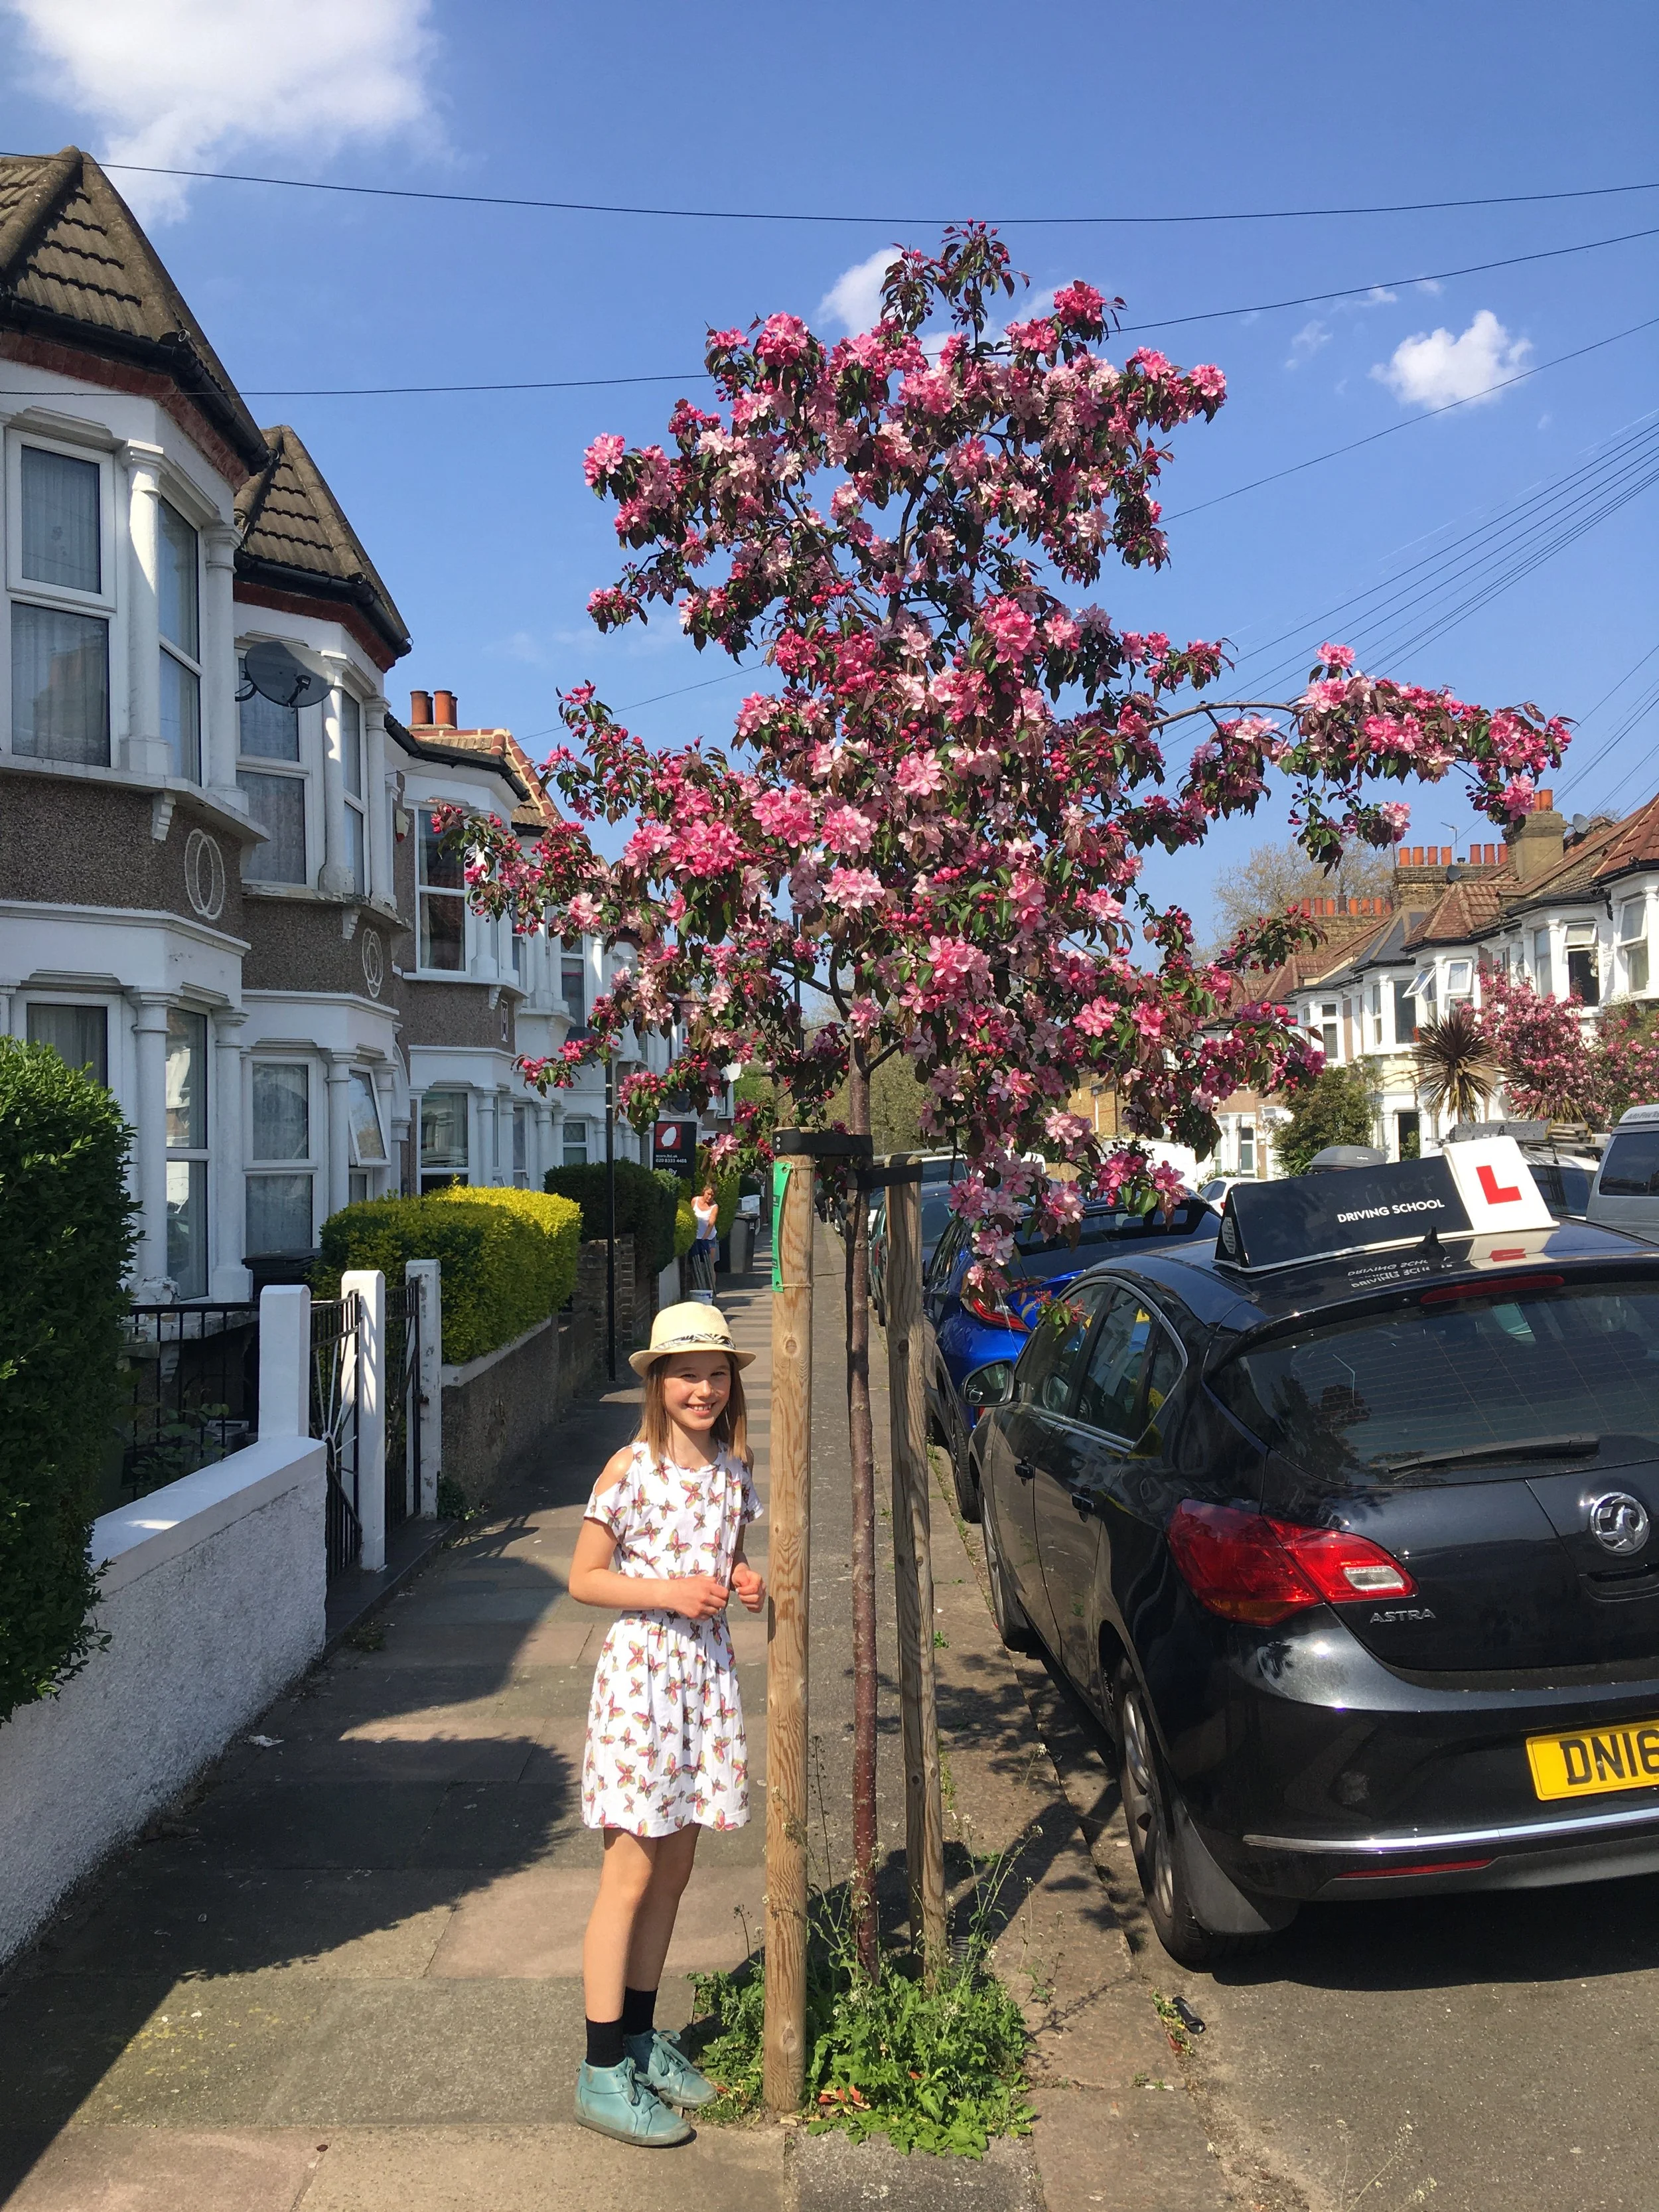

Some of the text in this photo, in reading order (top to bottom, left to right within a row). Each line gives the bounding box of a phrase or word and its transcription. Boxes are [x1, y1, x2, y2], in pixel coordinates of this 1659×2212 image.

[1476, 1165, 1522, 1205] L
[1337, 1199, 1445, 1223] DRIVING SCHOOL
[1370, 1608, 1436, 1623] ASTRA
[1559, 1729, 1659, 1786] DN16
